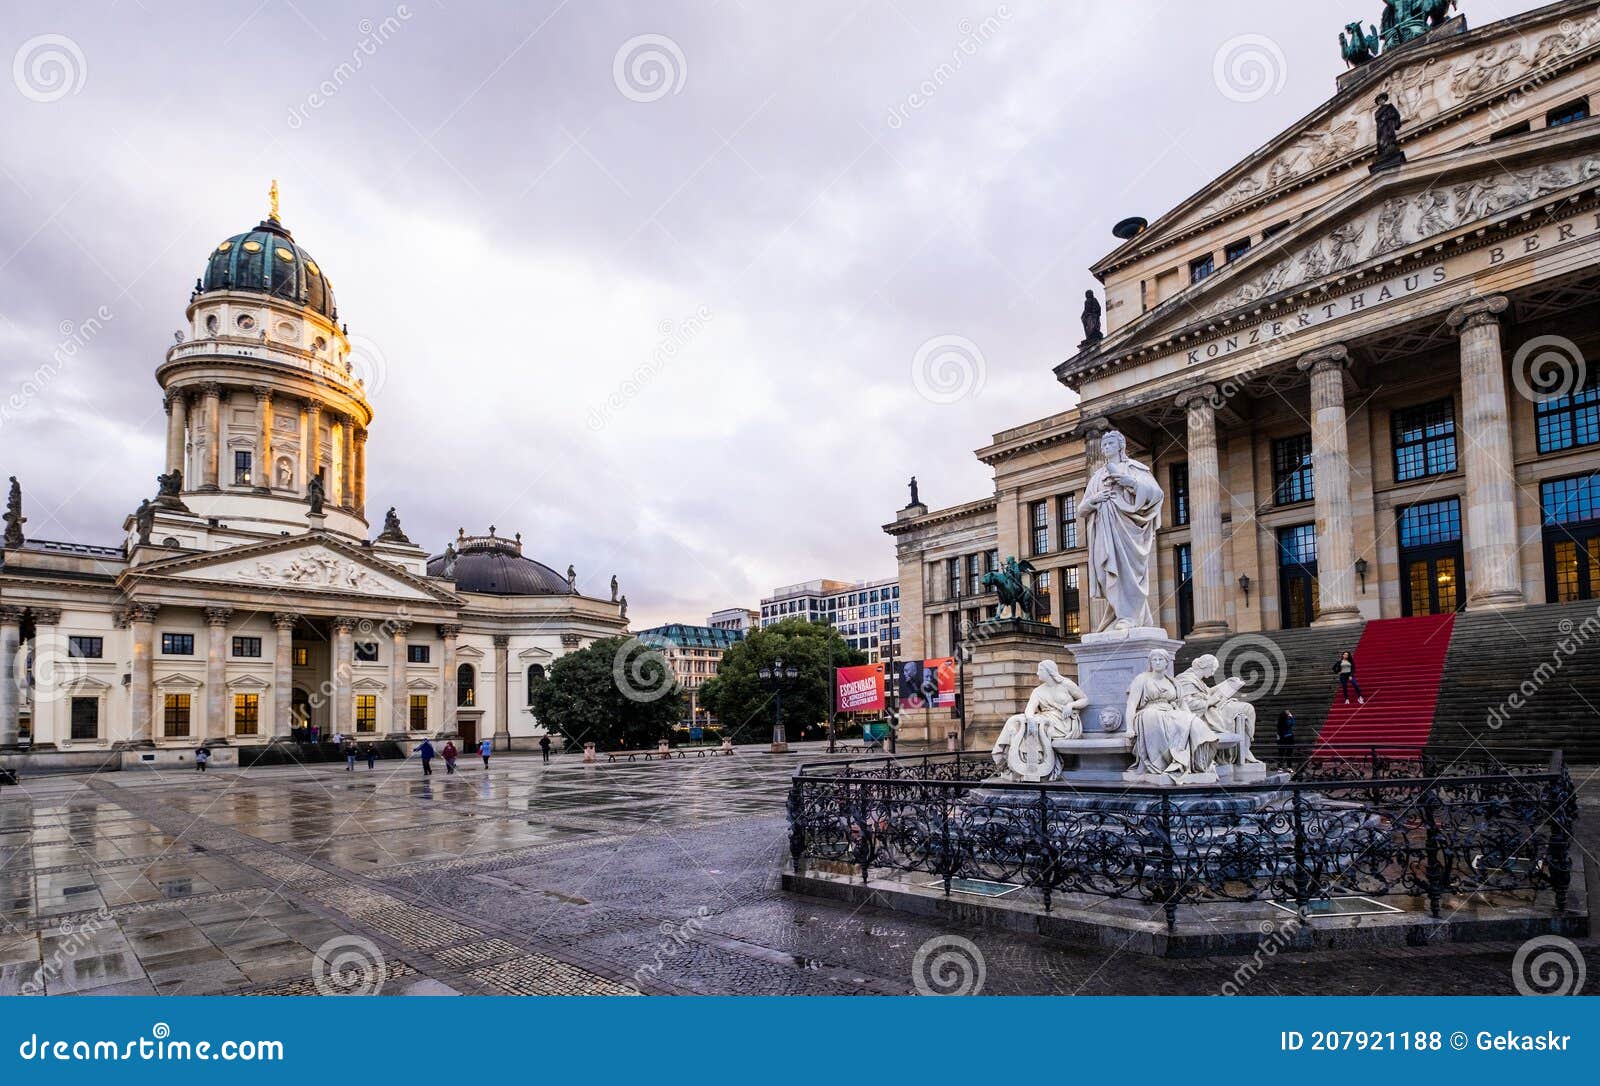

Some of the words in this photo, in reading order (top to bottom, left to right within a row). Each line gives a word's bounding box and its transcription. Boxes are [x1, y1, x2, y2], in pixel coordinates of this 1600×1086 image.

[1187, 265, 1447, 365] KONZERTHAUS
[839, 676, 876, 697] ESCHENBACH
[841, 696, 850, 709] &
